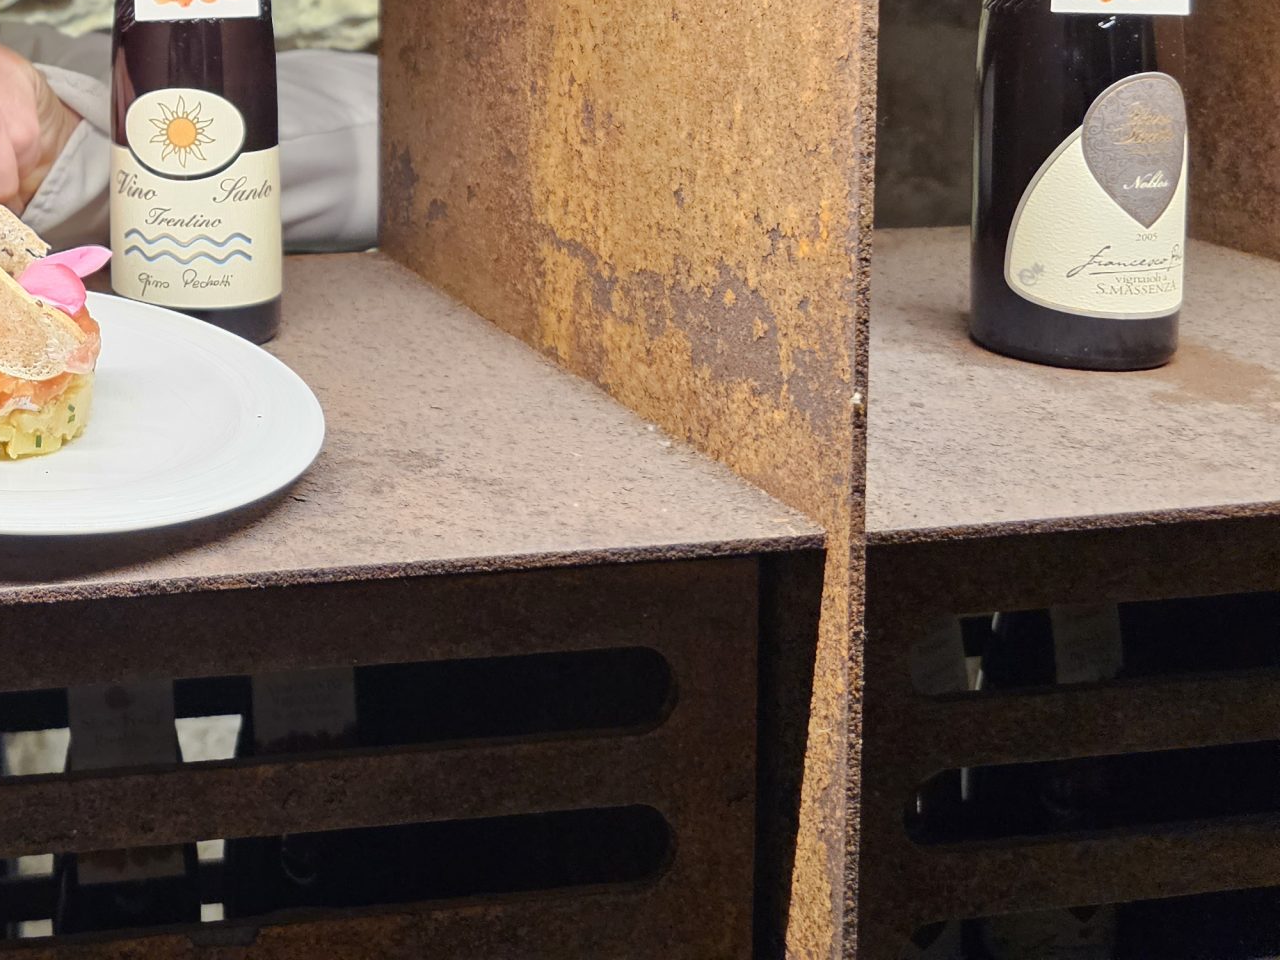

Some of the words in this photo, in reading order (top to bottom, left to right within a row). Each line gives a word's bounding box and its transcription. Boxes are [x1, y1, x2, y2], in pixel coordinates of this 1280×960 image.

[116, 169, 158, 200] Vino
[212, 176, 272, 203] Santo
[145, 207, 223, 228] Trentino
[1136, 232, 1158, 242] 2005
